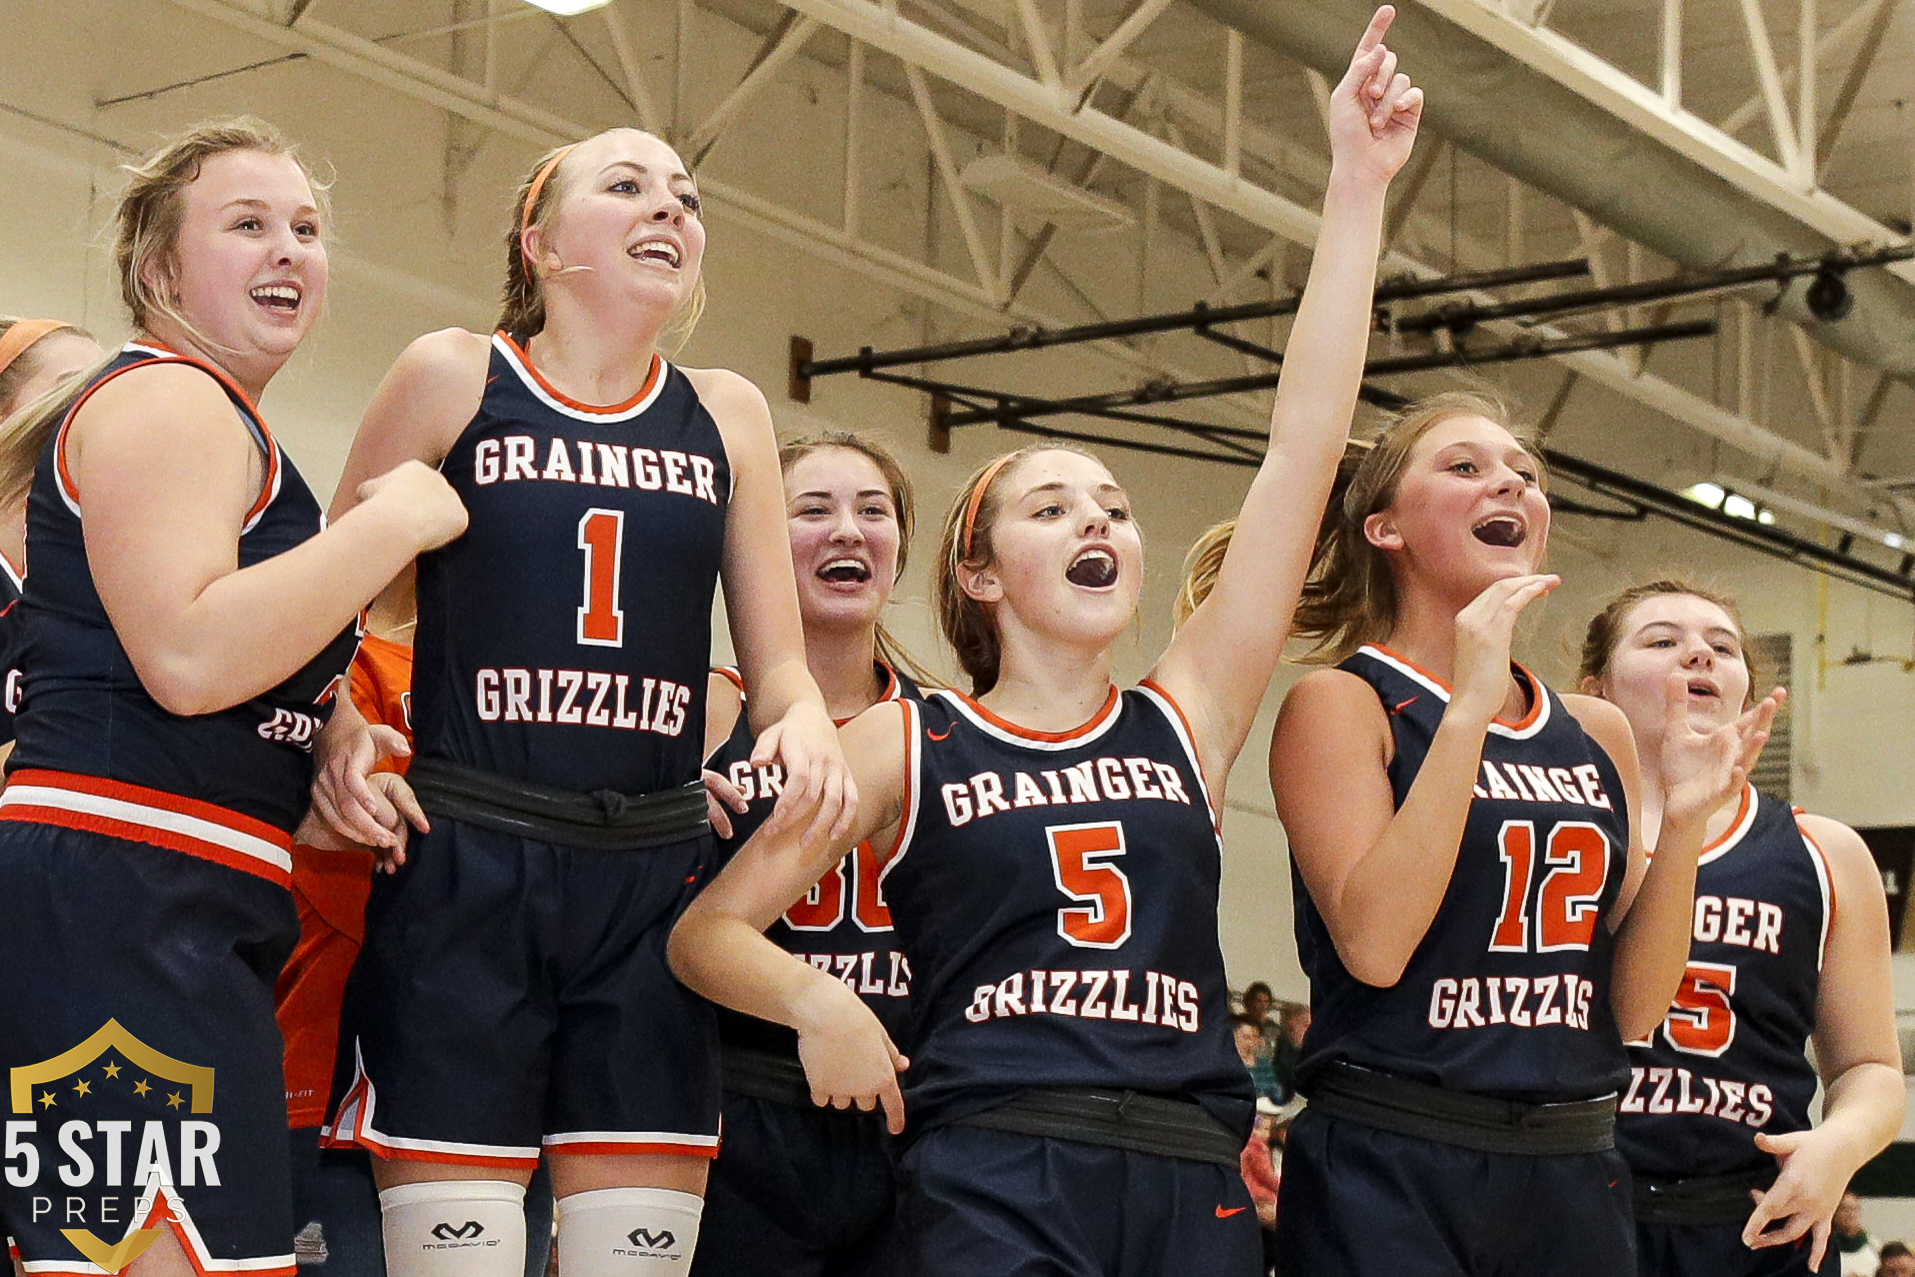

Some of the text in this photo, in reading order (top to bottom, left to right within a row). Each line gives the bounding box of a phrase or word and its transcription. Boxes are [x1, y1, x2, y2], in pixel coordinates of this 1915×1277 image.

[474, 435, 717, 505] GRAINGER
[577, 507, 624, 648] 1
[475, 668, 690, 737] GRIZZLIES
[941, 757, 1190, 827] GRAINGER
[1472, 760, 1614, 813] AINGE
[1045, 820, 1131, 950] 5
[1488, 819, 1611, 954] 12
[965, 968, 1198, 1033] GRIZZLIES
[1620, 1066, 1774, 1128] ZZLIES
